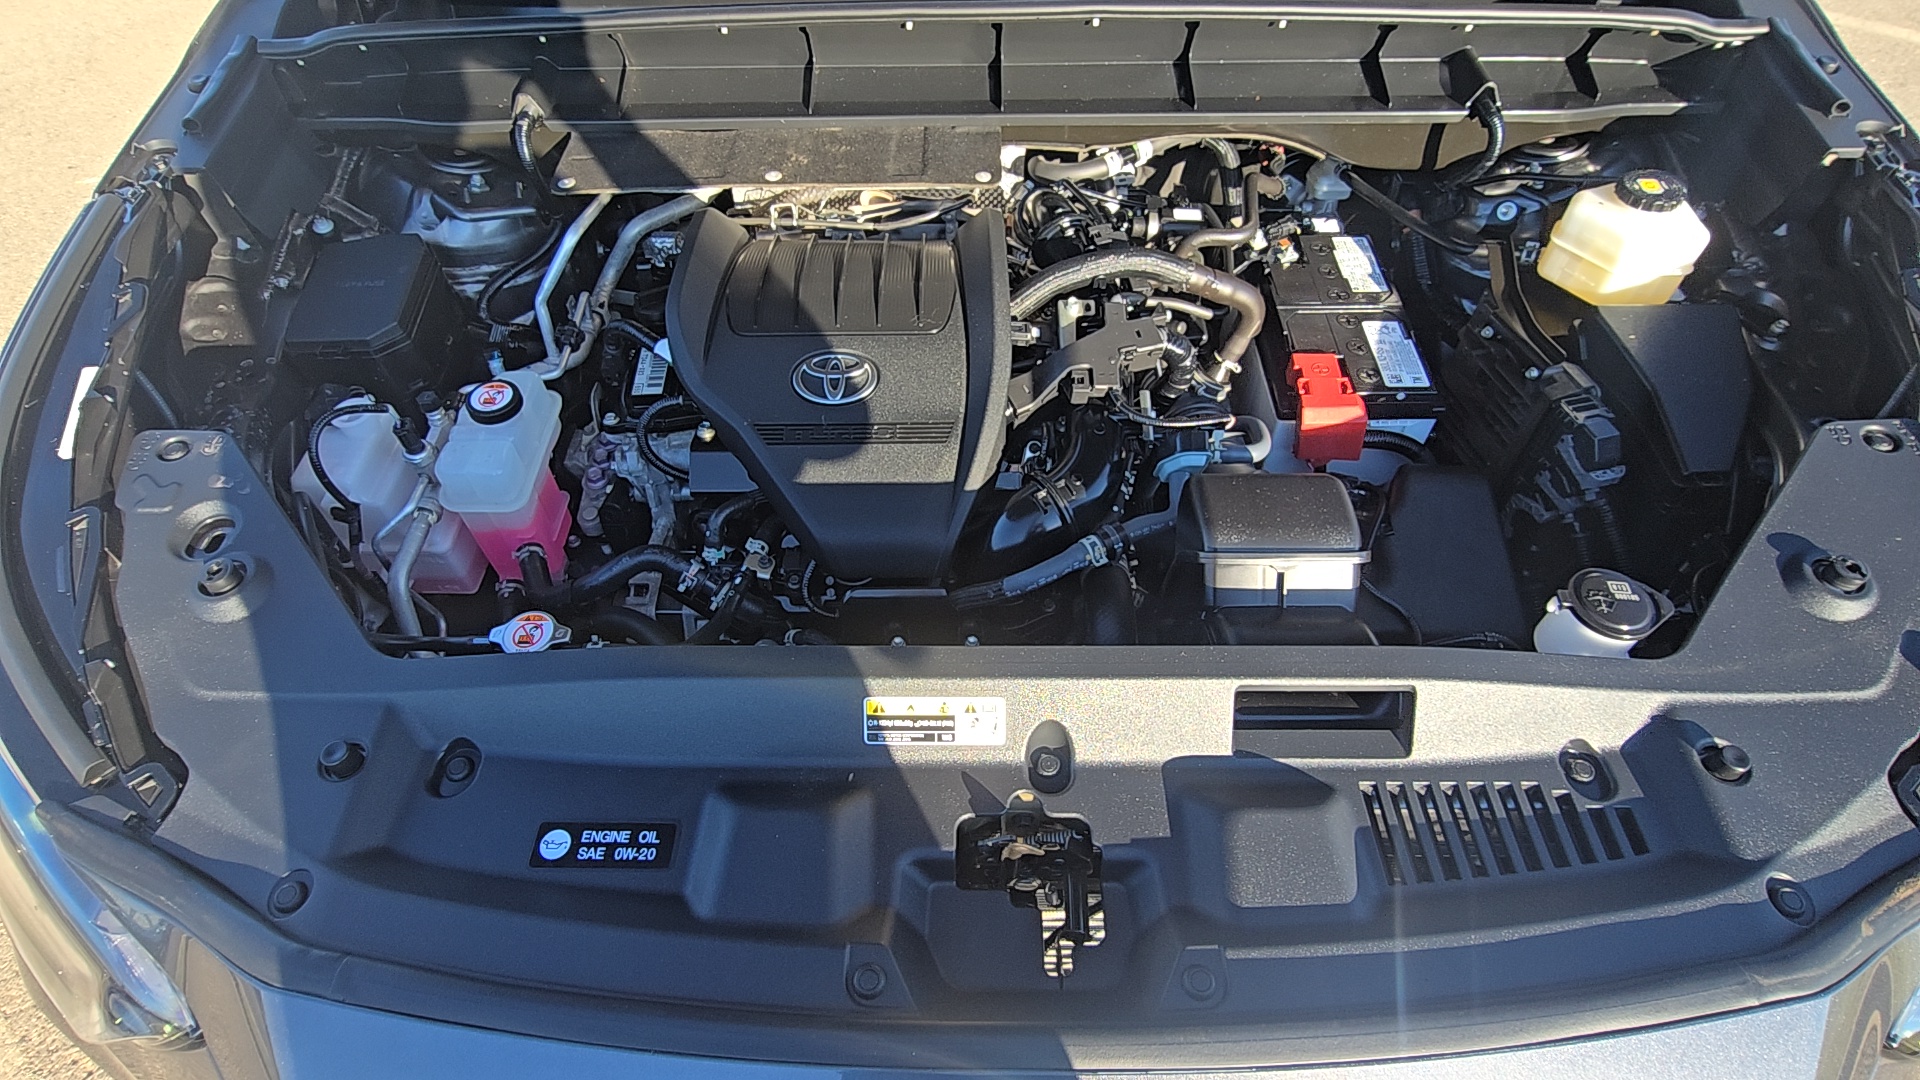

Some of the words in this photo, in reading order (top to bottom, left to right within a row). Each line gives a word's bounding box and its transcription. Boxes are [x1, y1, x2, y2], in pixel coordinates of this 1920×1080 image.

[580, 830, 632, 843] ENGINE
[638, 830, 661, 844] OIL
[576, 846, 607, 860] SAE
[614, 847, 657, 861] 0W-20
